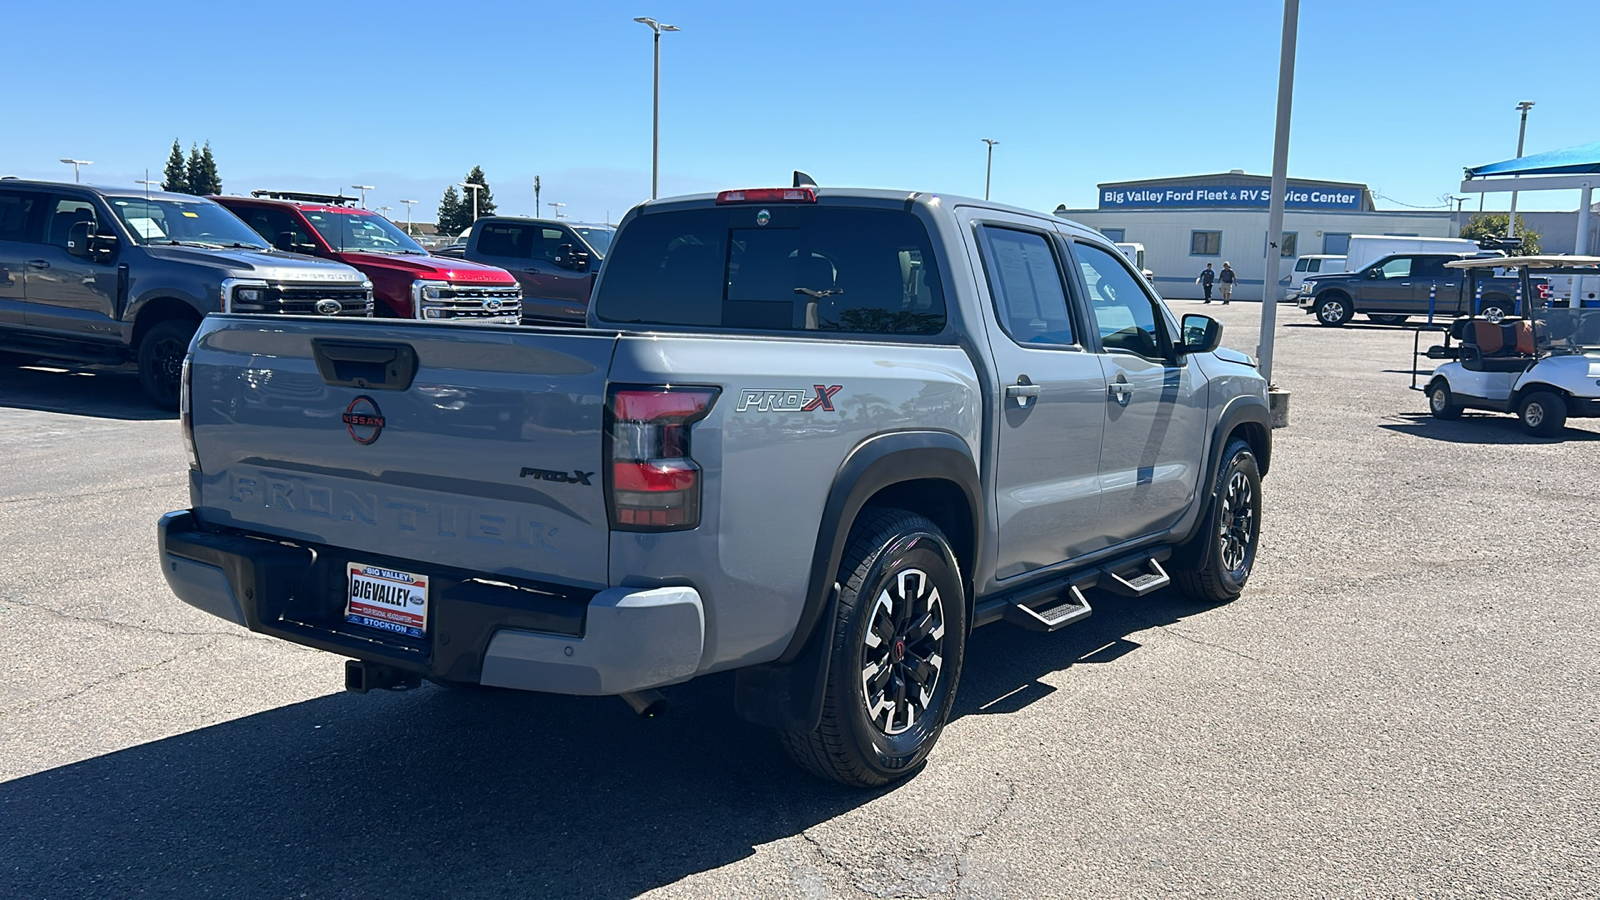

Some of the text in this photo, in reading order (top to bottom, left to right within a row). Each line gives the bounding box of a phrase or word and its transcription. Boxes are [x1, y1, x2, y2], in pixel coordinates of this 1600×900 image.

[1104, 190, 1355, 204] Big Valley Ford Fleet & RV Svice Center
[735, 385, 843, 412] PRO-X
[343, 414, 383, 427] NISSAN
[229, 474, 561, 553] FRONTIER
[366, 567, 409, 581] BIG VALLEY
[363, 618, 407, 633] STOCKTON
